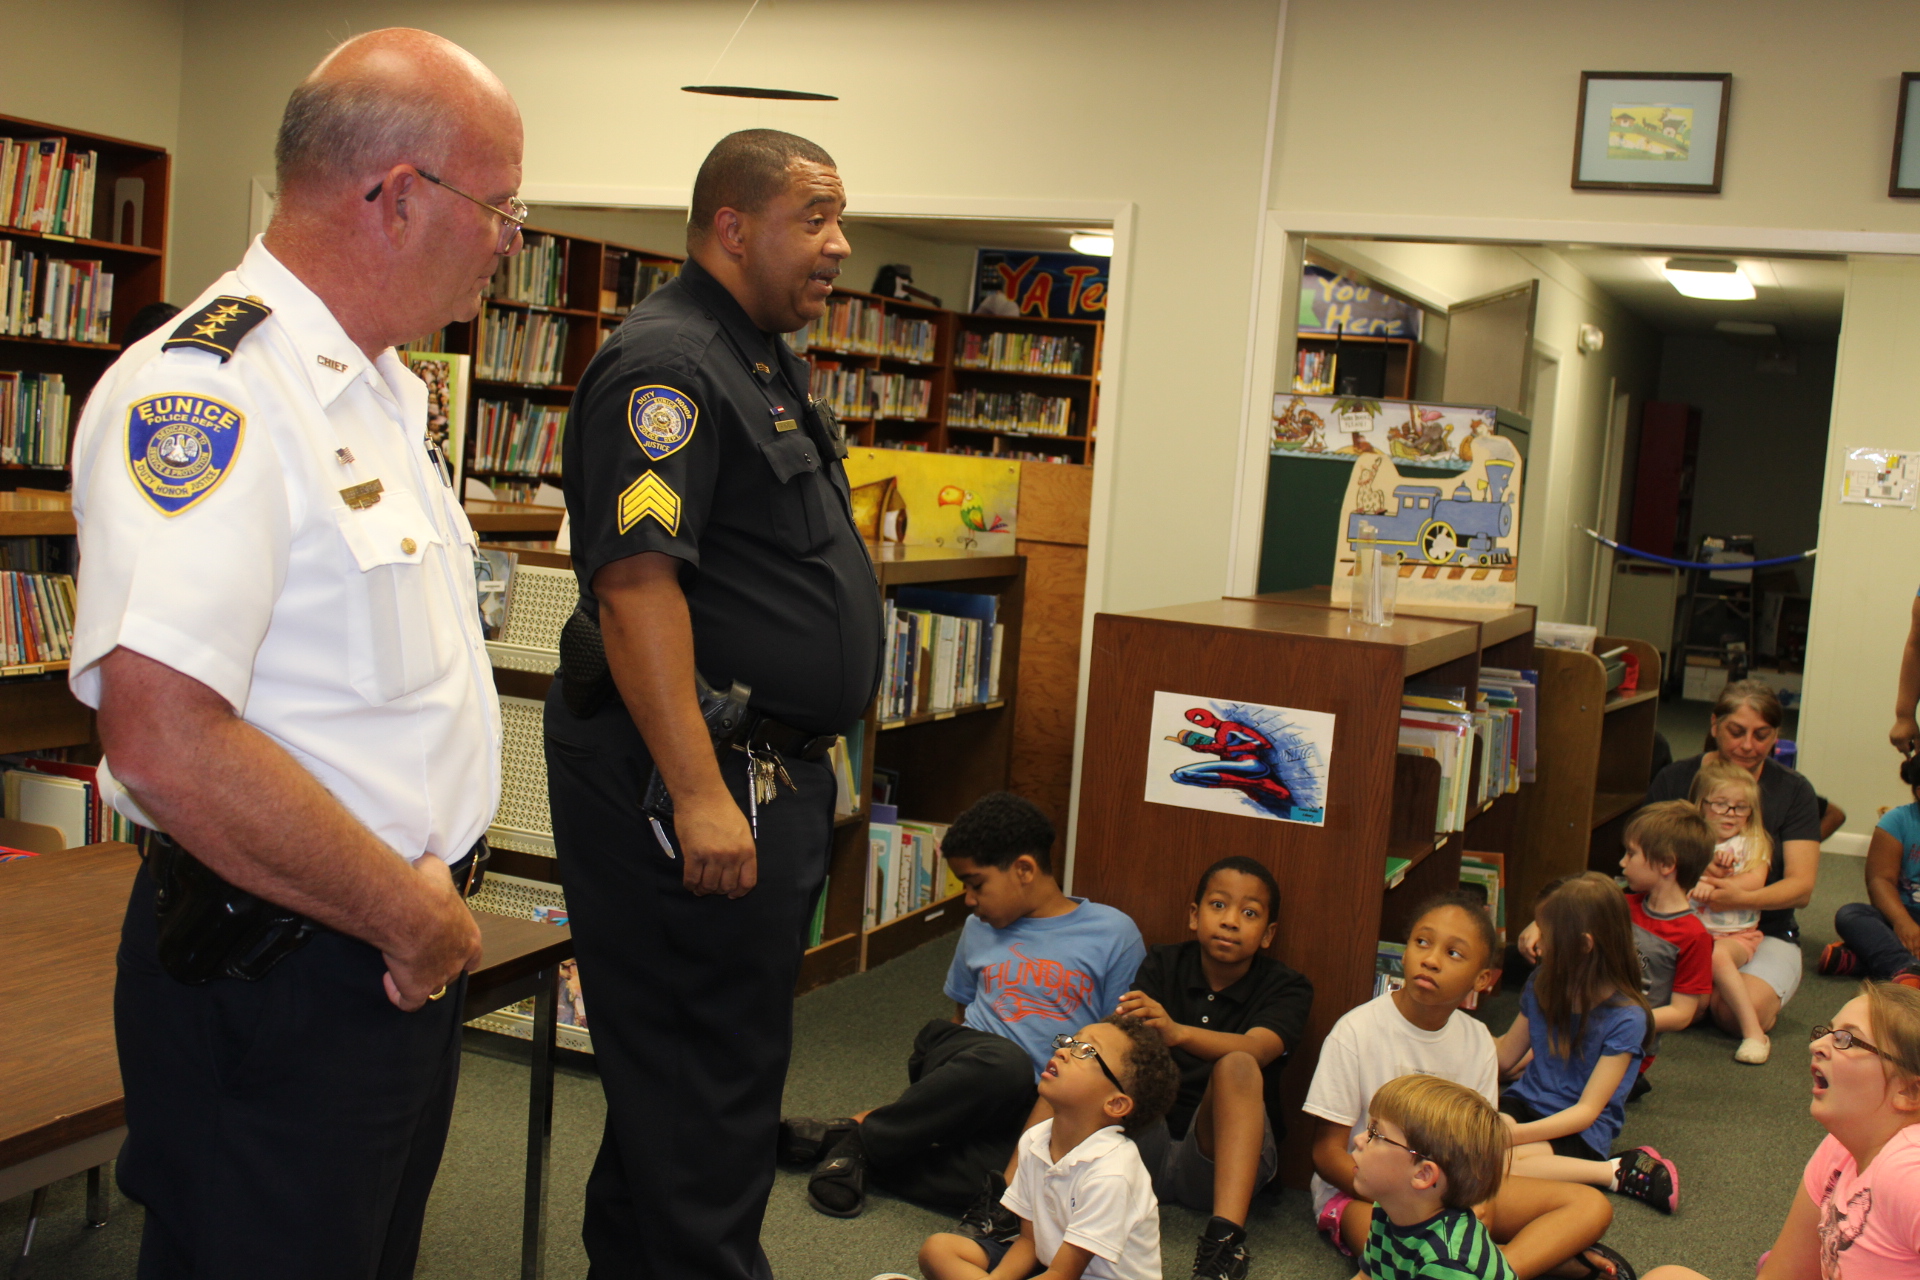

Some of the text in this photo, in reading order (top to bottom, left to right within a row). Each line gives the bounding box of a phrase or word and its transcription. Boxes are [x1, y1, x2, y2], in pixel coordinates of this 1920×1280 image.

[998, 256, 1053, 319] YA
[1318, 275, 1371, 302] You
[1325, 304, 1402, 335] Here
[317, 355, 348, 373] CHIEF
[137, 398, 238, 429] EUNICE
[636, 391, 692, 420] DUTY HONOR
[146, 414, 221, 433] POLICE DEPT.
[156, 424, 207, 445] DEDICATED TO
[643, 440, 671, 452] JUSTICE
[136, 464, 216, 495] DUTY HONOR JUSTICE
[981, 958, 1095, 1006] THUNDER
